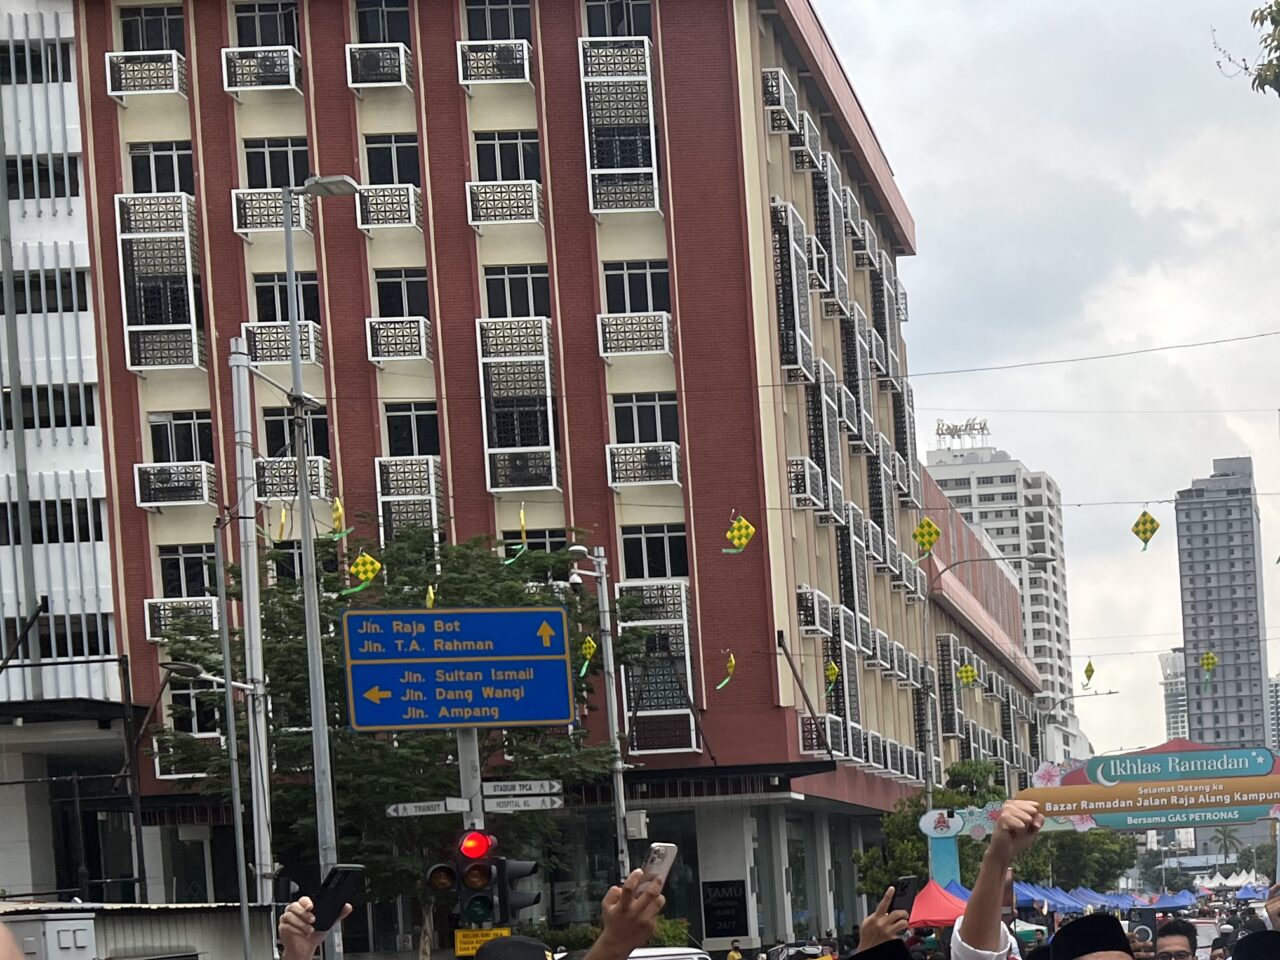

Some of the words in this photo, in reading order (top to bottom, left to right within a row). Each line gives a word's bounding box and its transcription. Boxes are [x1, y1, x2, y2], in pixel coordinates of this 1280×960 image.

[358, 620, 384, 633] Jln.
[392, 620, 426, 636] Raja
[434, 619, 461, 633] Bot
[359, 640, 386, 652] Jln.
[395, 639, 425, 652] T.A.
[434, 638, 494, 651] Rahman
[400, 671, 426, 683] Jln.
[435, 668, 483, 681] Sultan
[491, 667, 534, 680] Ismail
[401, 689, 427, 701] Jln.
[436, 688, 473, 703] Dang
[482, 685, 525, 701] Wangi
[402, 707, 428, 719] Jln.
[438, 705, 499, 719] Ampang
[1110, 758, 1161, 776] Ikhlas
[1168, 754, 1249, 773] Ramadan
[493, 784, 517, 792] STADIUM
[1138, 784, 1175, 795] Selamat
[1177, 783, 1210, 794] Datang
[1213, 783, 1224, 791] ke
[414, 804, 441, 813] TRANSIT
[496, 800, 521, 808] HOSPITAL
[1045, 801, 1078, 812] Bazar
[1081, 799, 1133, 810] Ramadan
[1137, 796, 1168, 807] Jalan
[1171, 794, 1195, 807] Raja
[1198, 792, 1230, 806] Alang
[1127, 815, 1166, 825] Bersama
[1168, 812, 1187, 822] GAS
[1189, 811, 1239, 821] PETRONAS
[707, 887, 742, 897] TAMU
